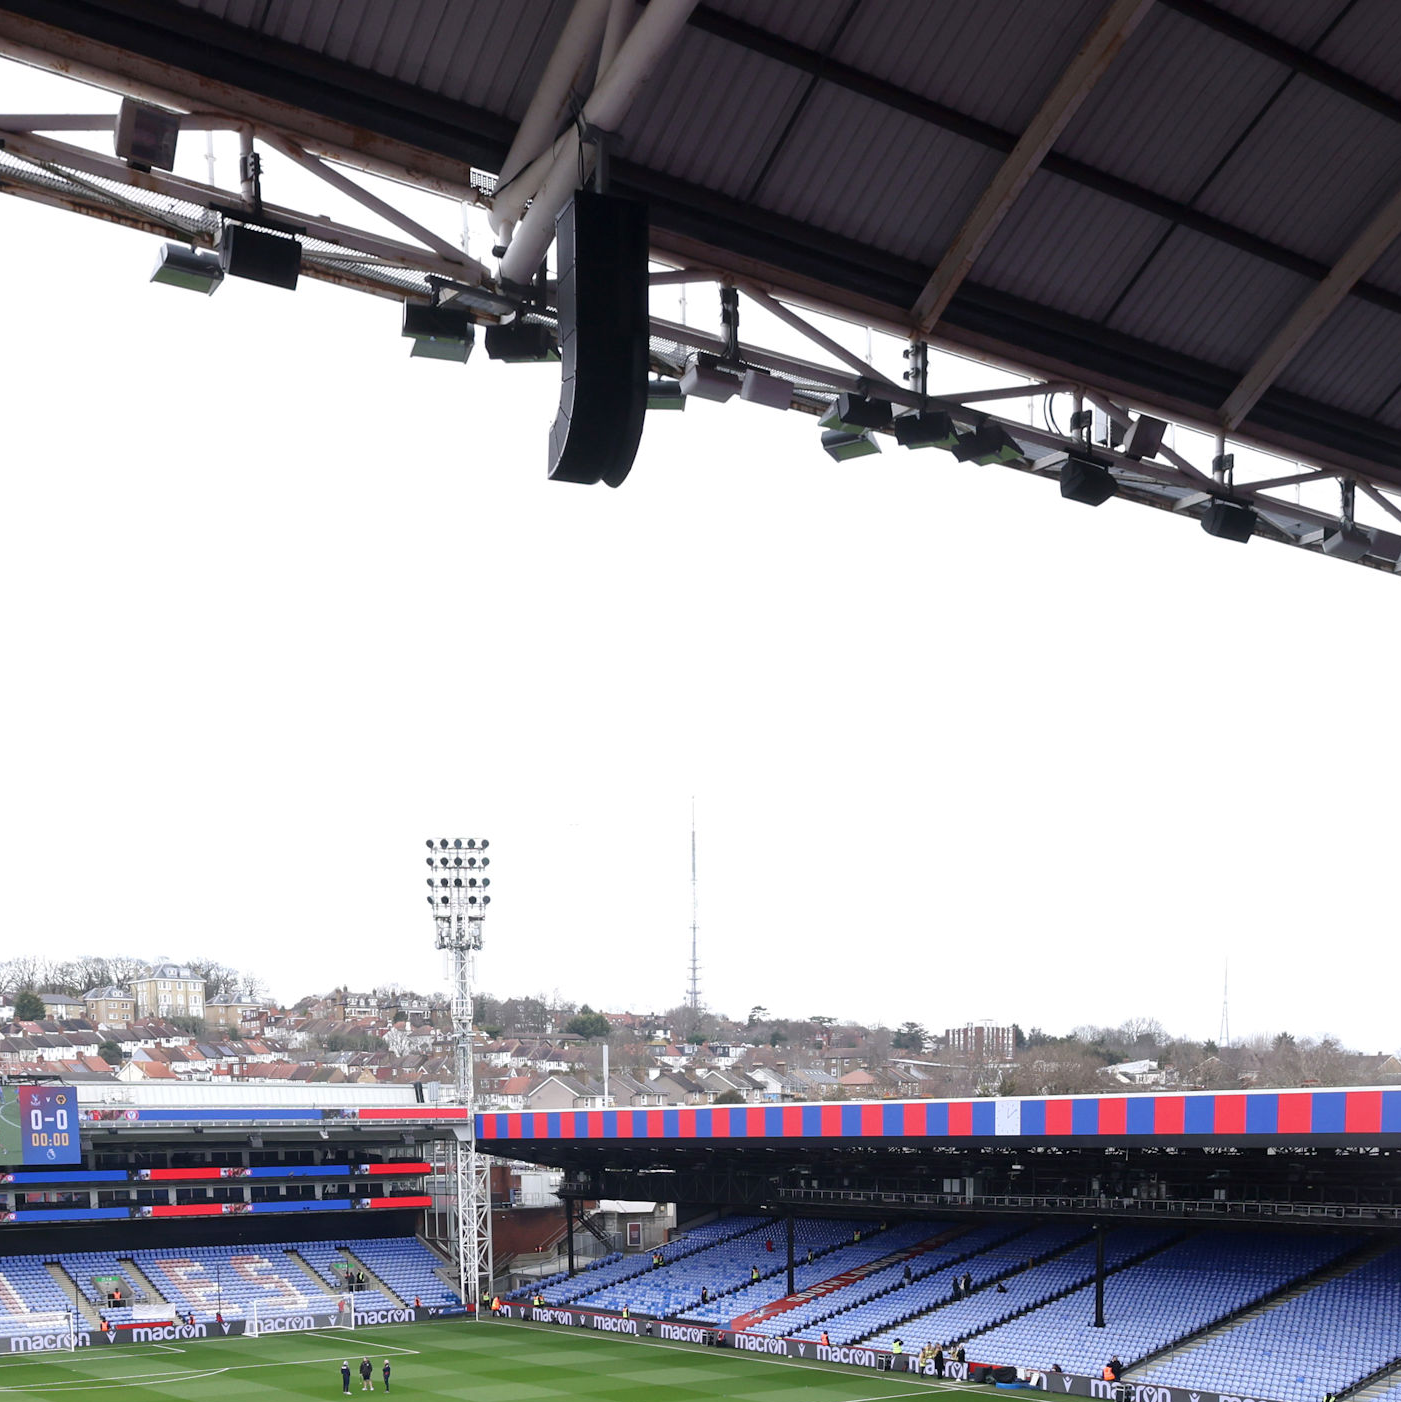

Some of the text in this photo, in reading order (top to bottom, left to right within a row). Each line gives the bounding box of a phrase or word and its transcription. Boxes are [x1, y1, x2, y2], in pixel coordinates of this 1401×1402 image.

[30, 1109, 68, 1131] 0-0
[31, 1133, 70, 1147] 00:00
[247, 1315, 314, 1332] macron
[354, 1308, 415, 1325] macron
[532, 1307, 572, 1326] macron
[594, 1315, 637, 1334] macron
[11, 1331, 90, 1351] macron
[133, 1323, 206, 1343] macron
[661, 1324, 707, 1345] macron
[735, 1333, 787, 1356] macron
[817, 1344, 876, 1368] macron
[909, 1355, 968, 1380] maron
